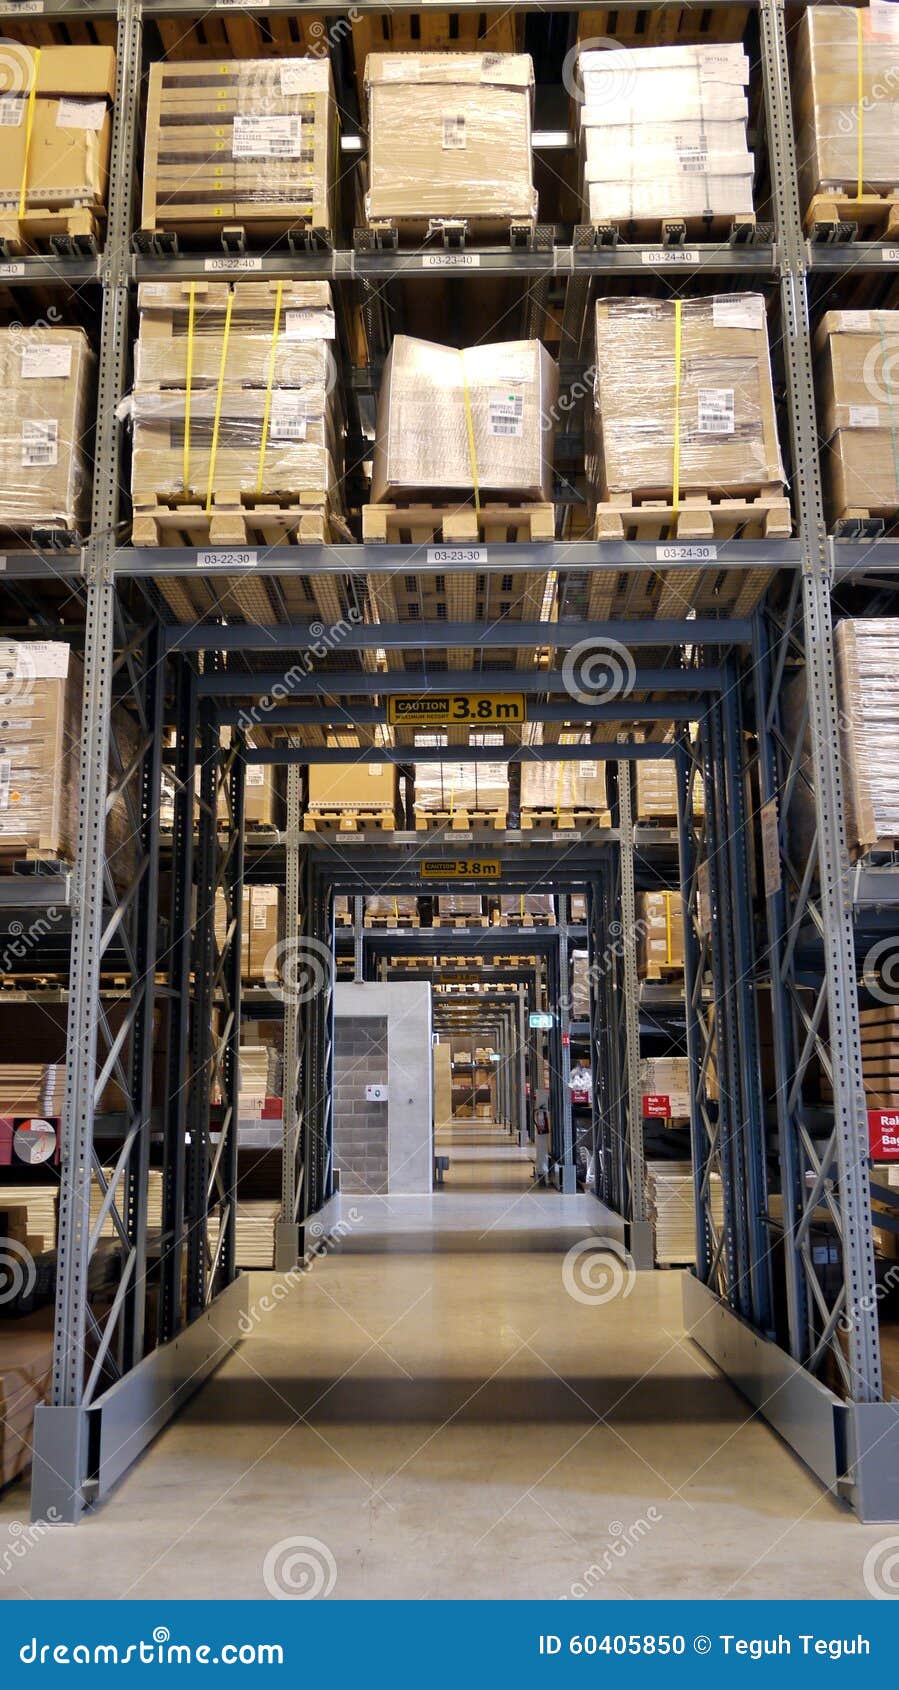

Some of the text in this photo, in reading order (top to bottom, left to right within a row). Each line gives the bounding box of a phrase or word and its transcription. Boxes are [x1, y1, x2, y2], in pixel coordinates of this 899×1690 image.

[429, 255, 473, 264] 03-23-40
[649, 252, 692, 261] 03-24-40
[212, 259, 255, 269] 03-22-40
[434, 551, 480, 561] 03-23-30
[664, 547, 710, 558] 03-24-30
[204, 554, 250, 564] 03-22-30
[398, 702, 447, 711] CAUTION
